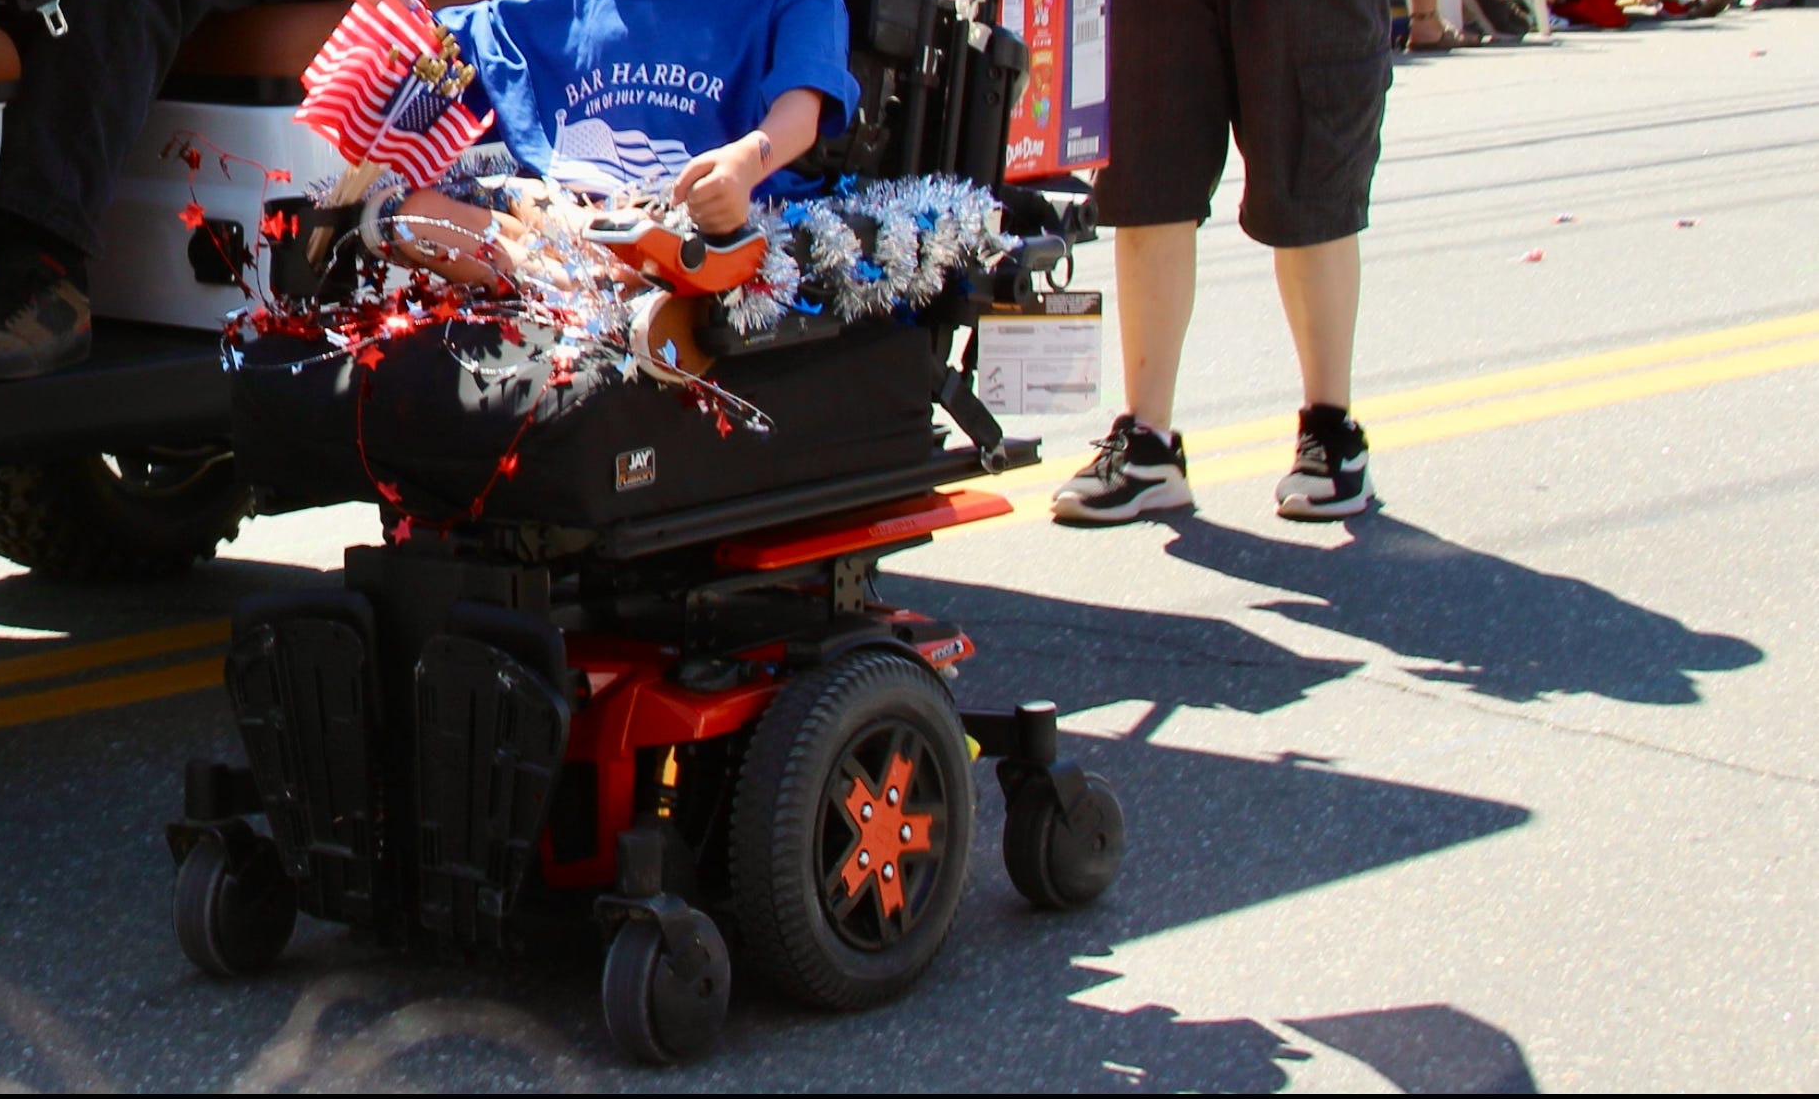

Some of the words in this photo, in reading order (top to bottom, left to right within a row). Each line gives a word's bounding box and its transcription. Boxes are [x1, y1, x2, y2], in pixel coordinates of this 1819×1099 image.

[565, 68, 604, 107] BAR
[610, 62, 724, 102] HARBOR
[584, 98, 602, 117] 4TH
[602, 91, 614, 109] OF
[615, 89, 645, 106] JULY
[647, 90, 697, 116] PARADE
[629, 450, 652, 471] JAY
